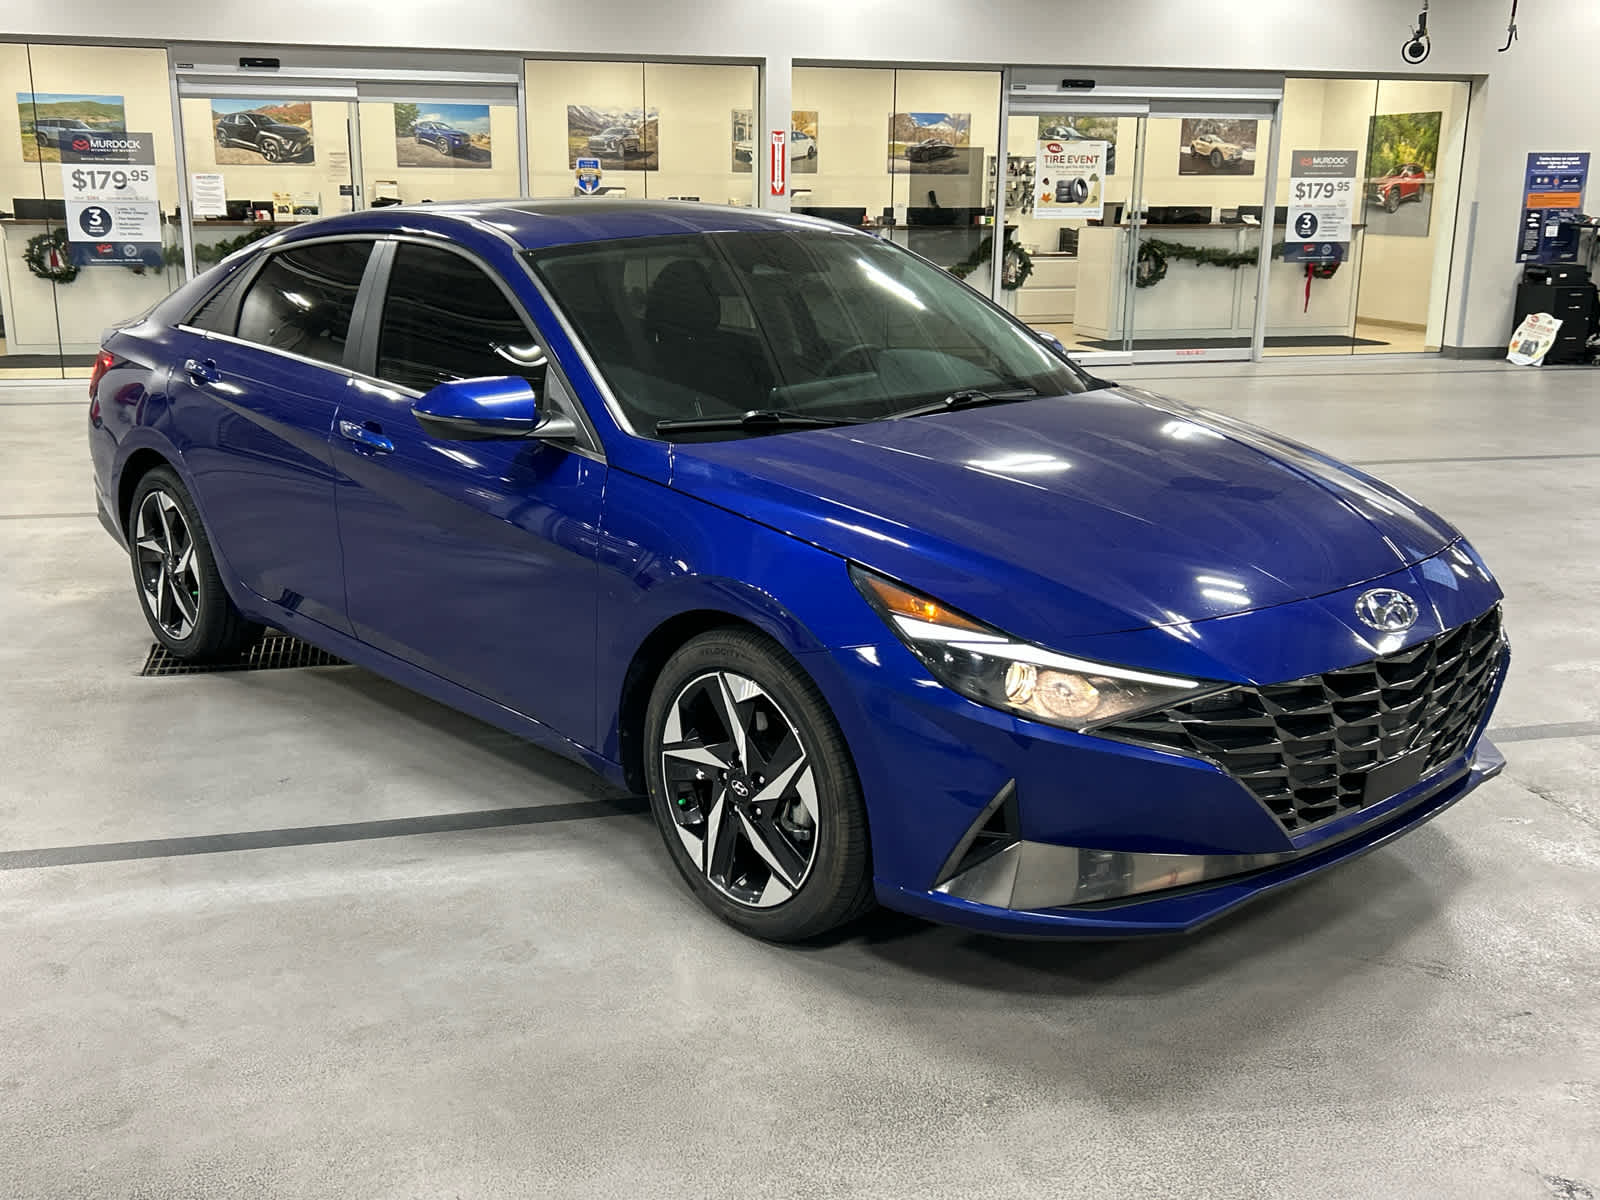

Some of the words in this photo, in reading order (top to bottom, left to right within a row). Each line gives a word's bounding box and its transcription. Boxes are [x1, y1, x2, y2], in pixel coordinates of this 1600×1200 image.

[90, 140, 141, 149] MURDOCK
[1044, 155, 1065, 164] TIRE
[1067, 155, 1100, 164] EVENT
[1312, 156, 1349, 165] MURDOCK
[71, 168, 149, 191] $179.95
[1295, 181, 1350, 200] $179.95
[88, 209, 102, 226] 3
[1301, 215, 1312, 229] 3
